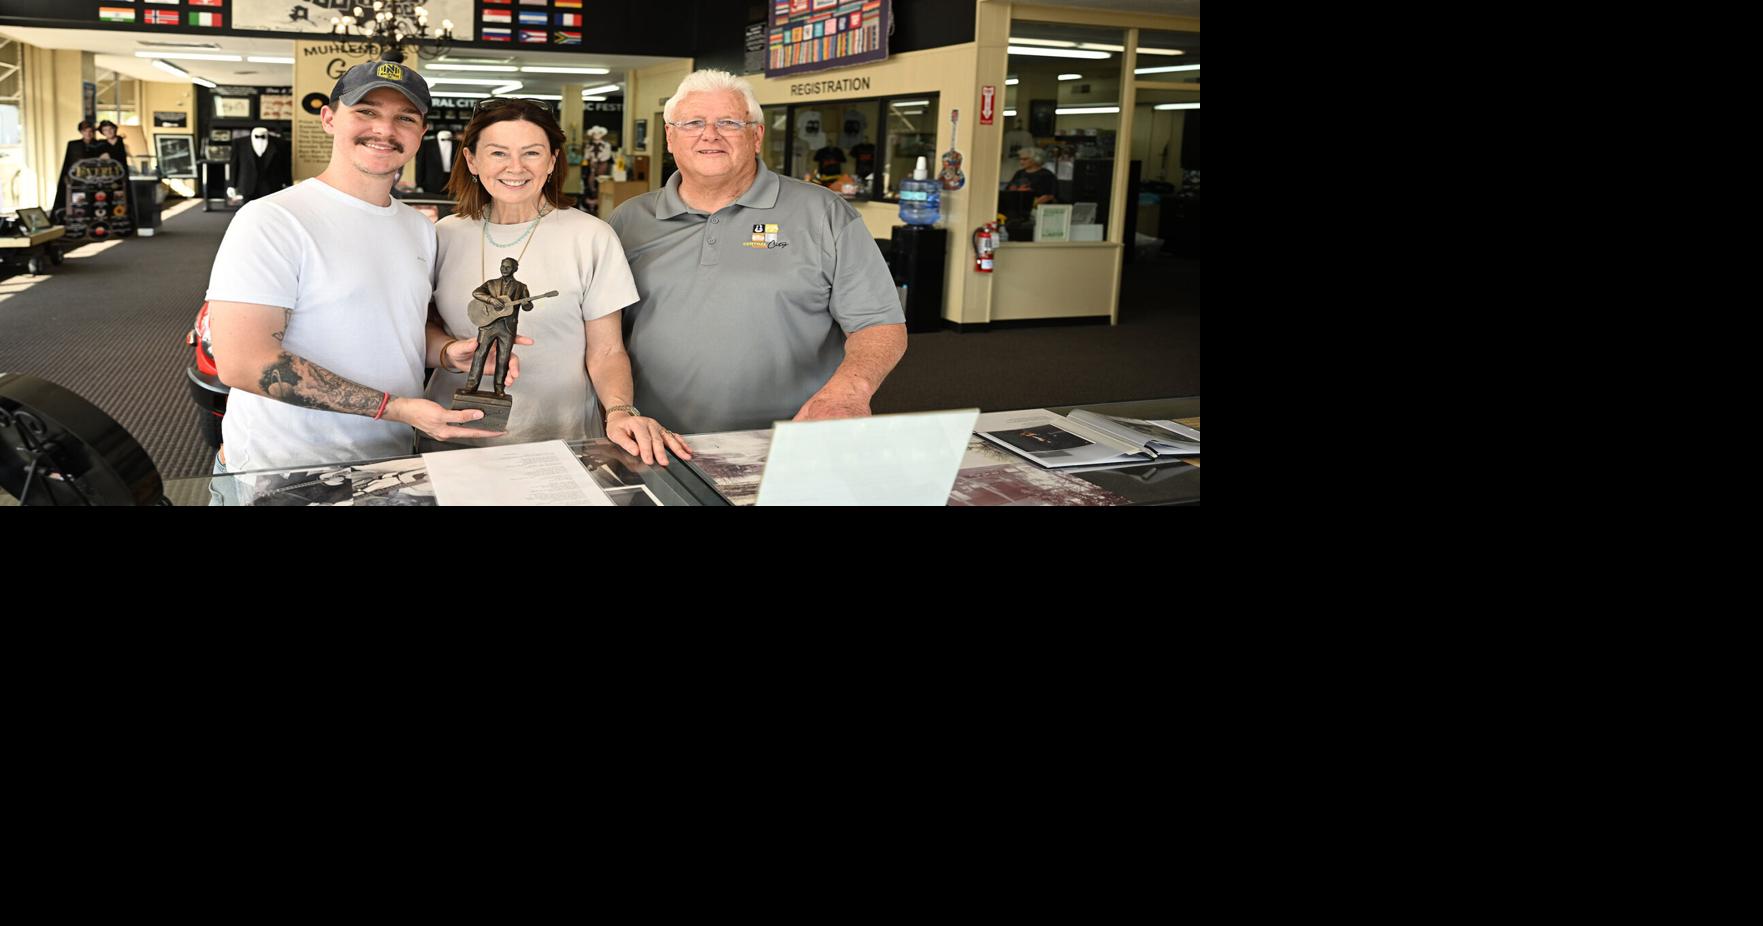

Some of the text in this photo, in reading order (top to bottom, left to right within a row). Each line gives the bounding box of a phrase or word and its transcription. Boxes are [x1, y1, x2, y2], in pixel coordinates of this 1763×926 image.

[791, 76, 870, 96] REGISTRATION
[431, 98, 477, 108] RAL CIT
[595, 102, 623, 111] FEST
